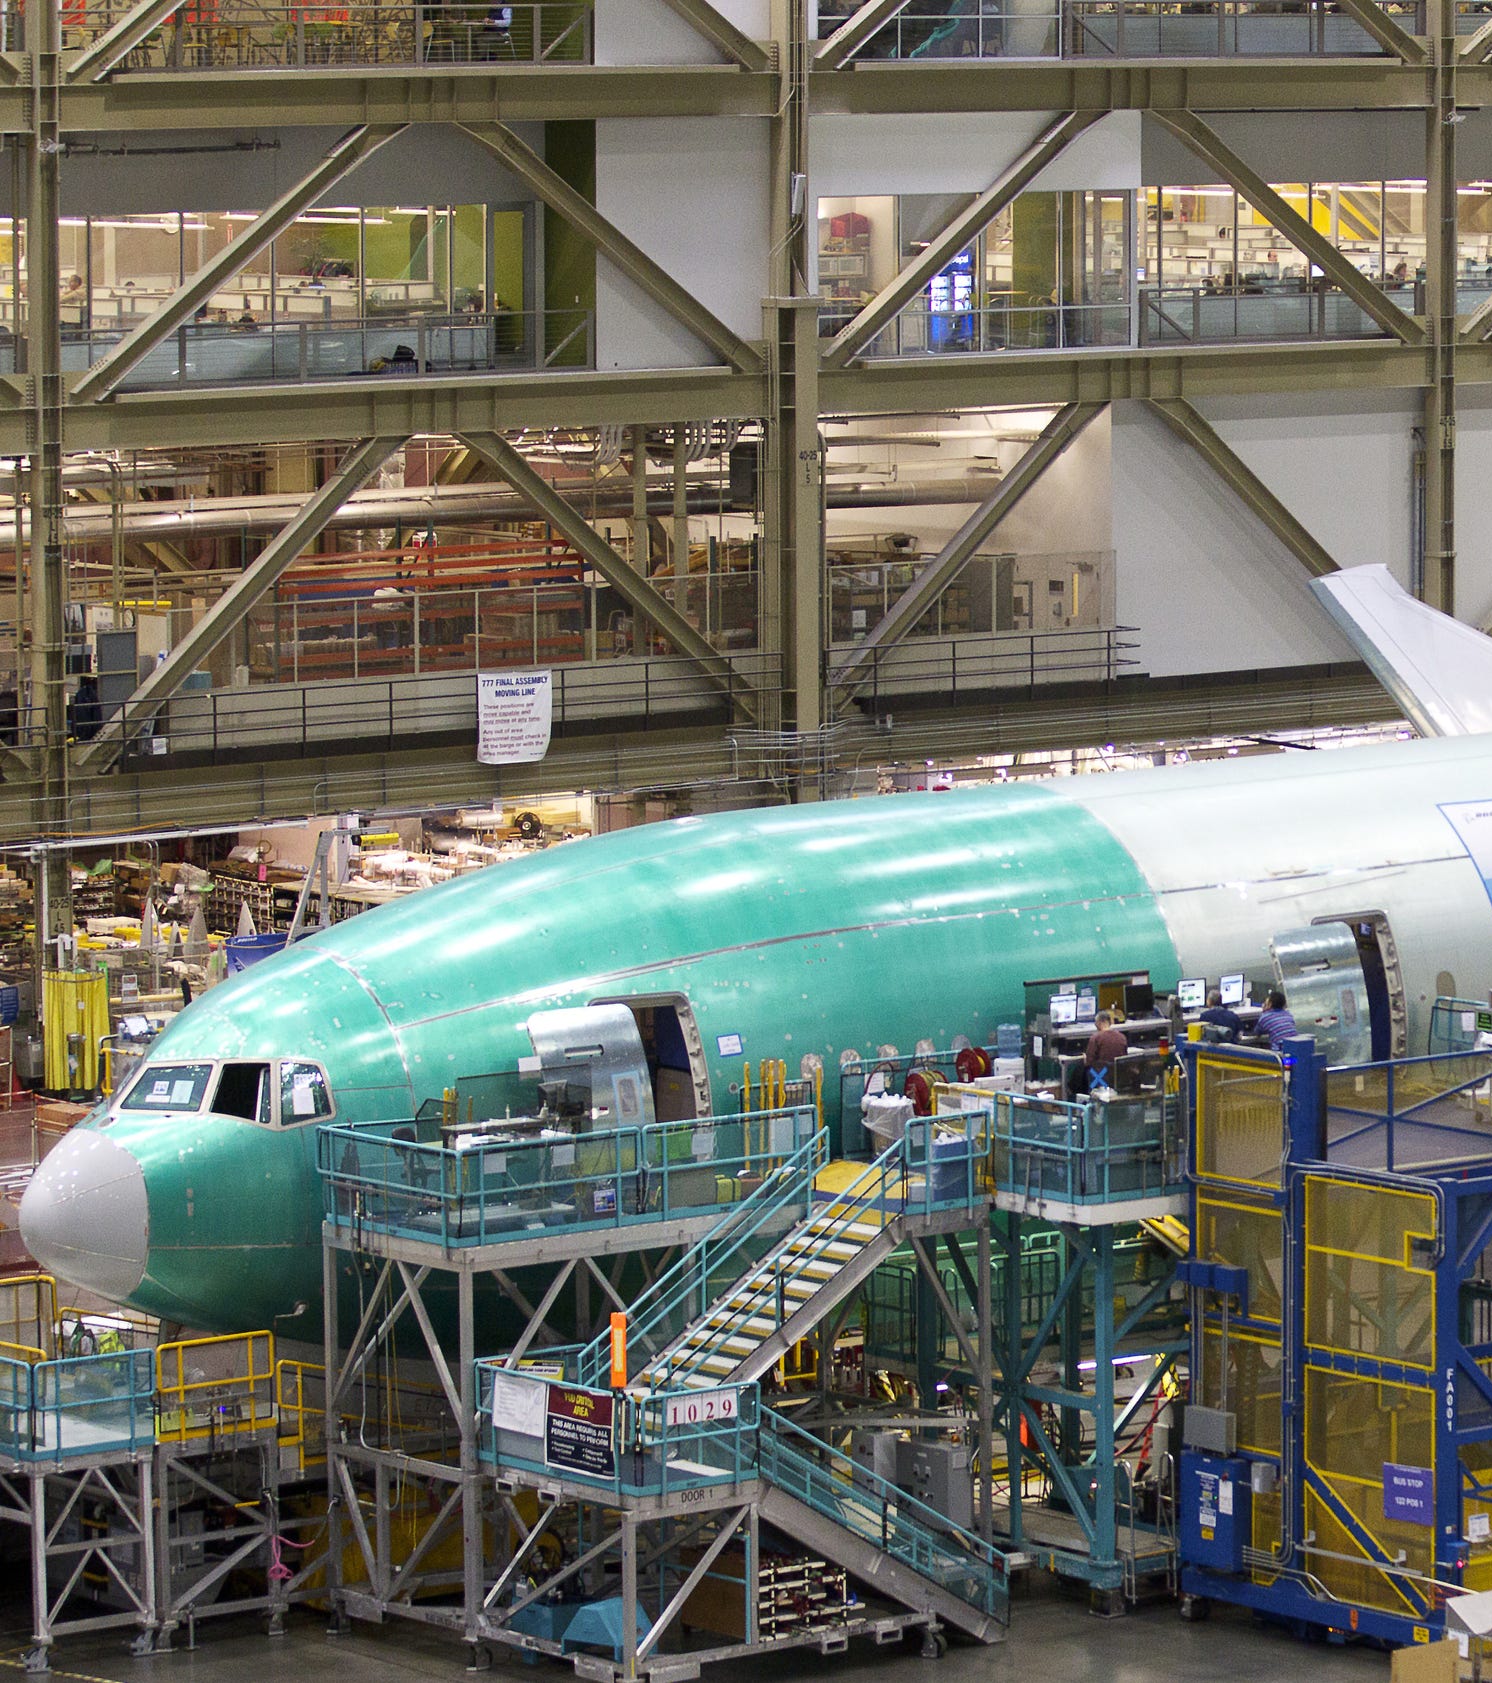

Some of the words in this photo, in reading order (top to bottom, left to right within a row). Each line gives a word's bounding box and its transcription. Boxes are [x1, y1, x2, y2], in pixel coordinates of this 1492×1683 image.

[482, 679, 494, 687] 777
[495, 679, 514, 687] FINAL
[515, 675, 548, 685] ASSEMBLY
[494, 689, 520, 697] MOVING
[521, 687, 536, 696] LINE
[1446, 1367, 1454, 1433] FA001
[572, 1405, 590, 1417] AREA
[550, 1427, 579, 1440] PERSONNEL
[579, 1433, 586, 1442] TO
[552, 1418, 564, 1427] THIS
[564, 1421, 576, 1431] AREA
[598, 1429, 609, 1438] ALL
[1407, 1478, 1424, 1488] STOP
[681, 1489, 705, 1503] DOOR
[709, 1488, 713, 1499] 1
